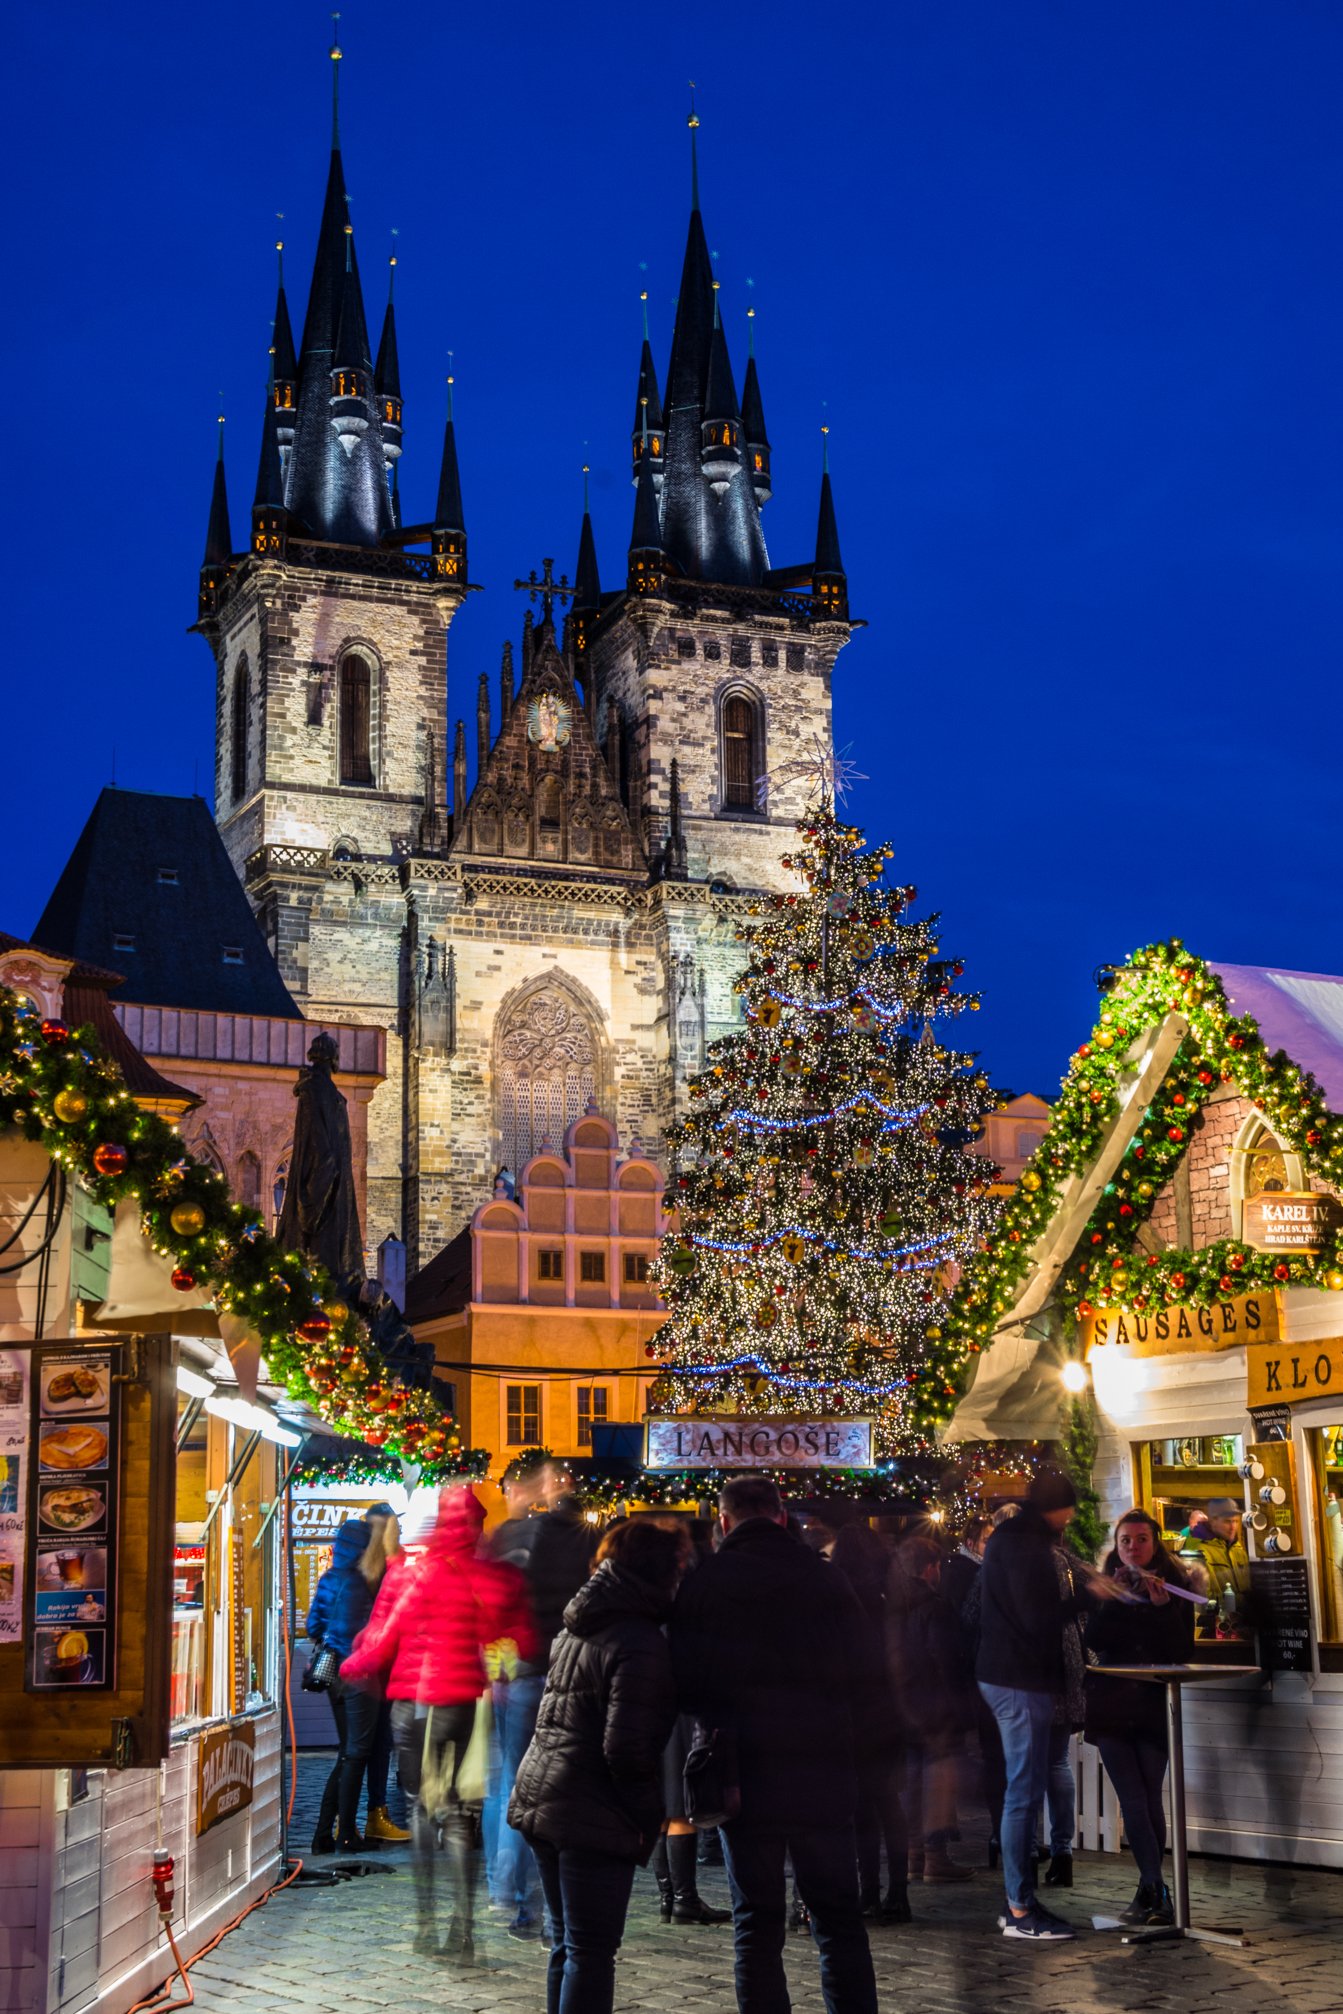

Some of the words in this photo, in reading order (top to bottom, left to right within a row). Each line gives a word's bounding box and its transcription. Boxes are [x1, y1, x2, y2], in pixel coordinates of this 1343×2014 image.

[1262, 1204, 1310, 1221] KAREL
[1312, 1206, 1329, 1221] IV.
[1267, 1224, 1290, 1233] KAPLE
[1265, 1235, 1286, 1244] HRAD
[1094, 1299, 1261, 1346] SAUSAGES
[1265, 1353, 1343, 1393] KLO
[676, 1426, 840, 1458] LANGOŠE
[291, 1500, 368, 1527] ČINK
[291, 1525, 340, 1537] ÊPES
[1288, 1640, 1304, 1649] WINE
